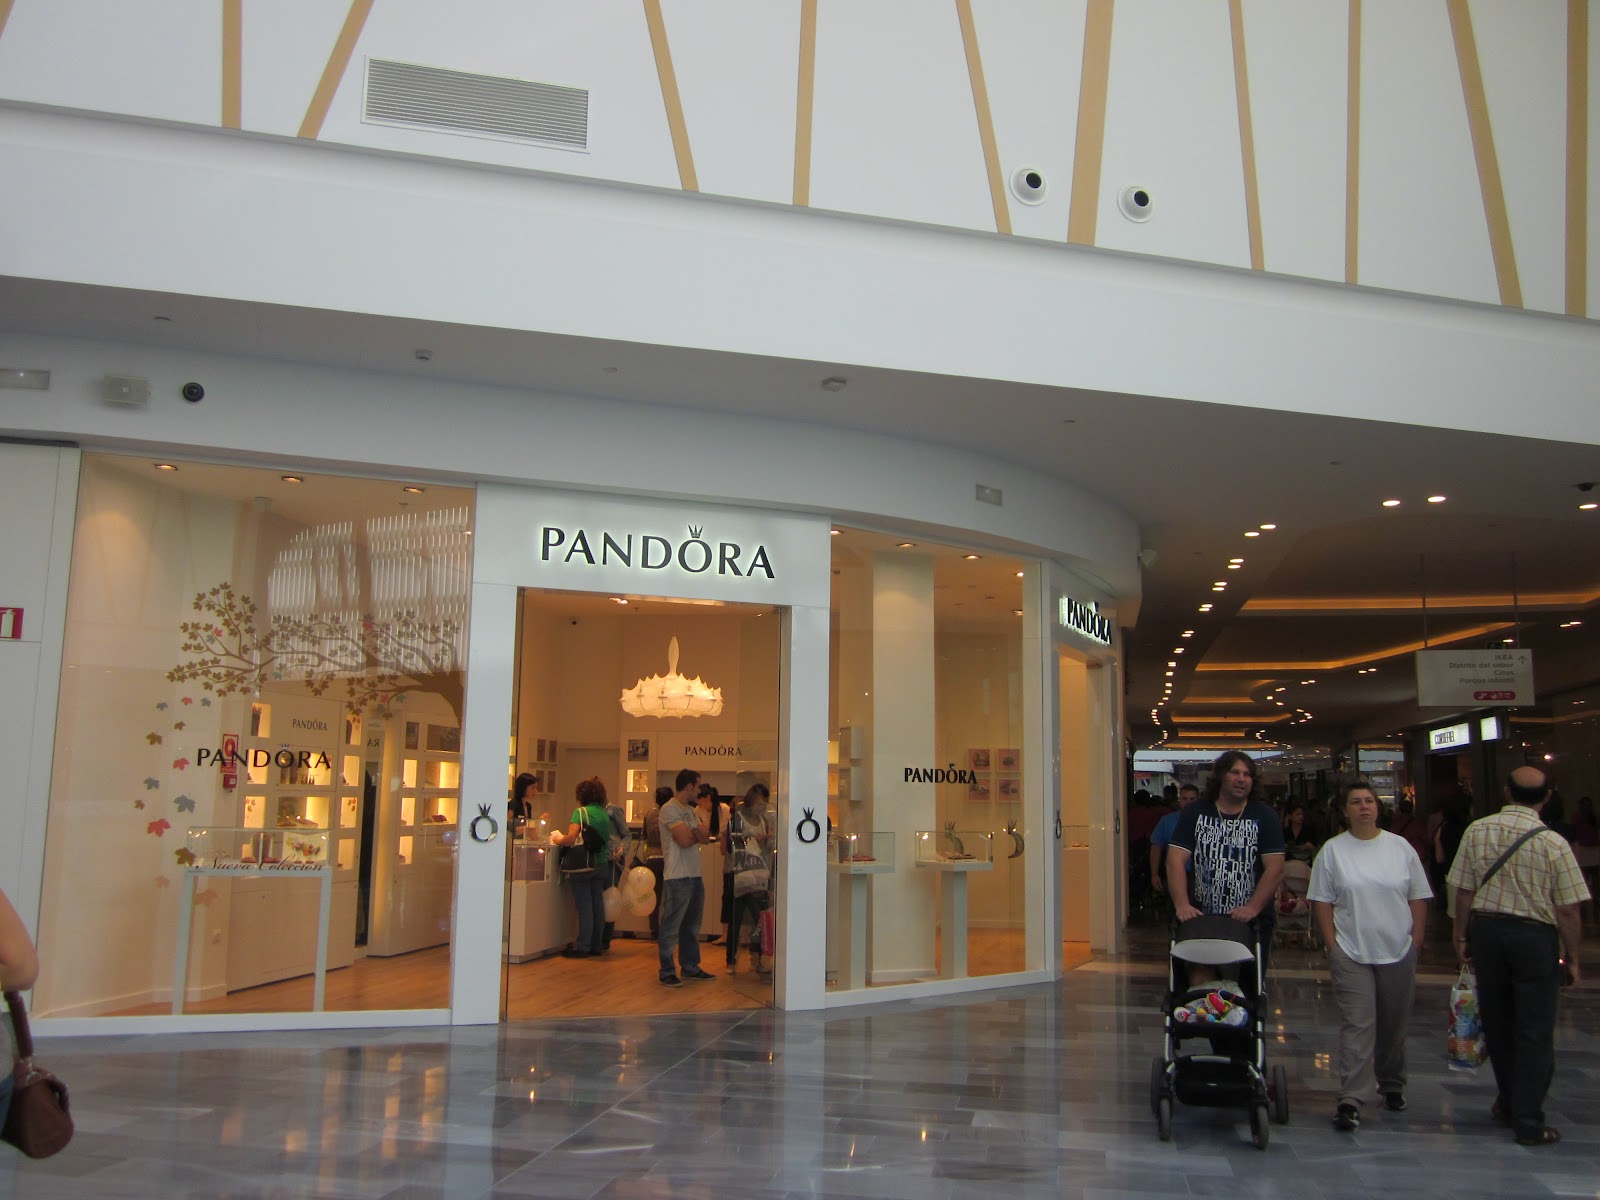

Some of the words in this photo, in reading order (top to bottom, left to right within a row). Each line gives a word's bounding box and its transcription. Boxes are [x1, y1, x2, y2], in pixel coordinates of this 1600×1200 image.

[541, 524, 775, 579] PANDORA
[1067, 597, 1112, 645] PANDORA
[292, 717, 328, 731] PANDORA
[197, 744, 332, 769] PANDORA
[685, 745, 742, 756] PANDORA
[904, 763, 977, 785] PANDORA
